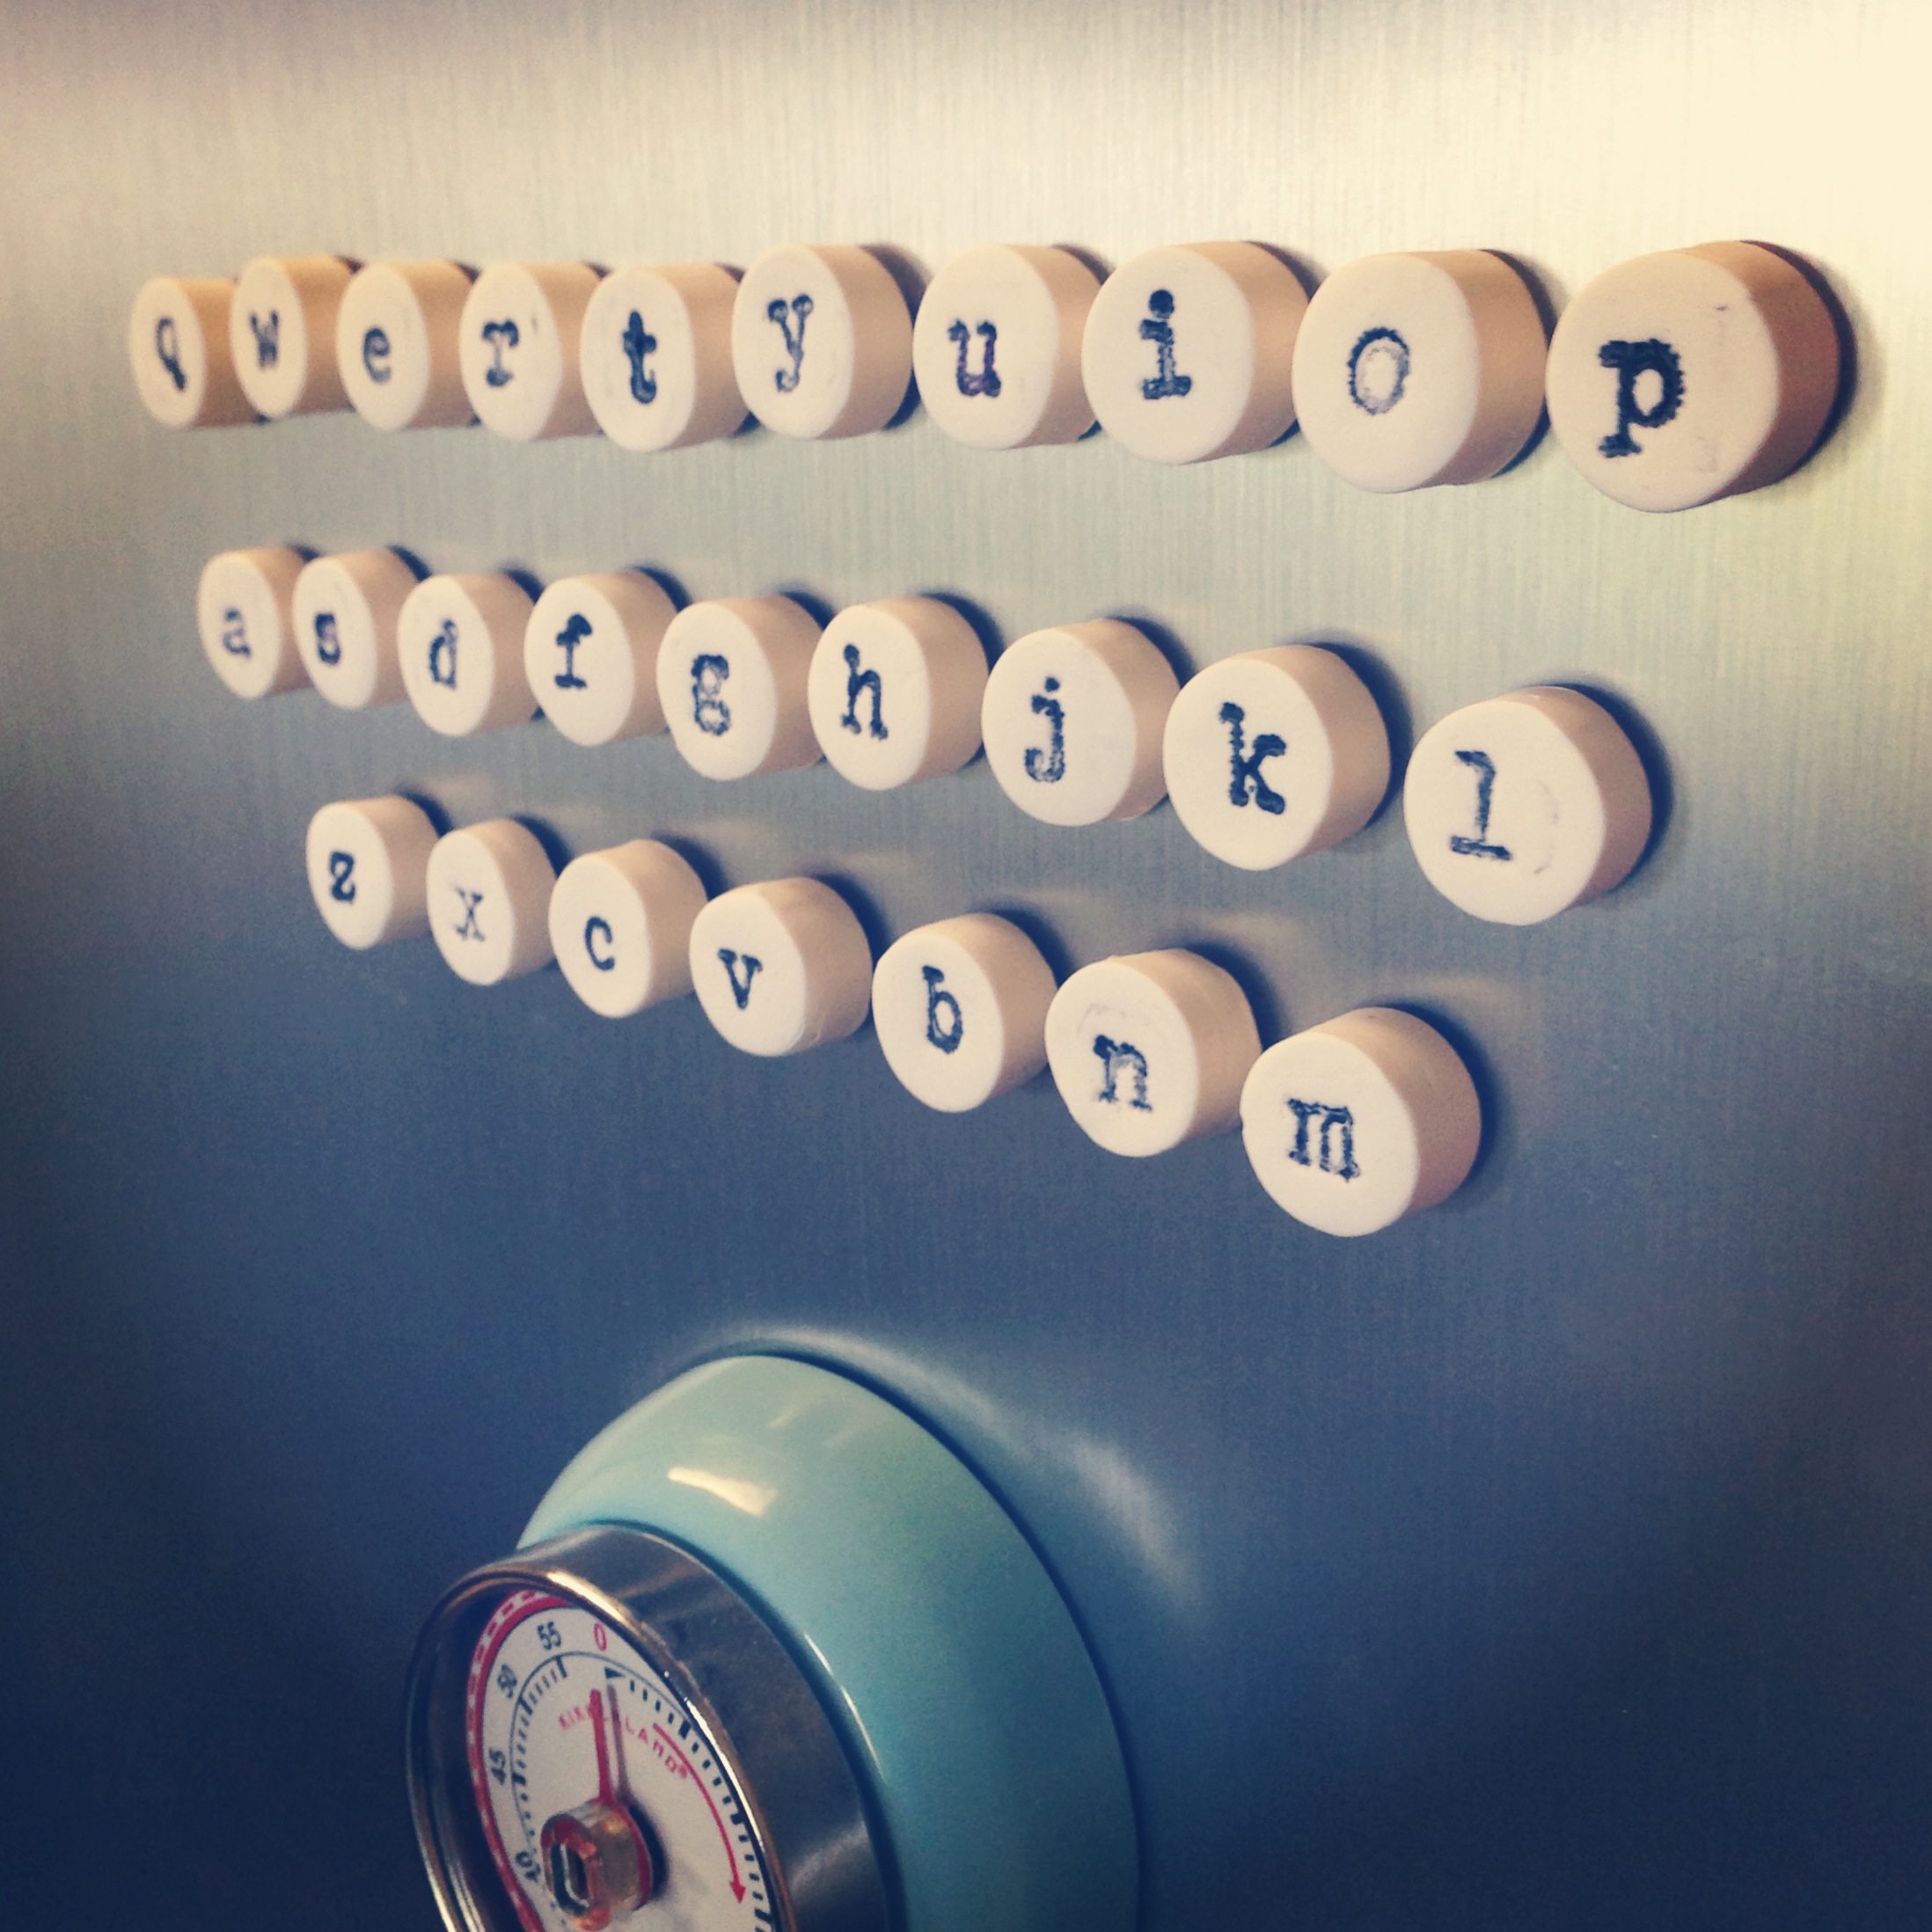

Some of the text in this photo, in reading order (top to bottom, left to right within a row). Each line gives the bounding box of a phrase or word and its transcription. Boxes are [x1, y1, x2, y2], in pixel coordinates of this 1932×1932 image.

[156, 289, 1686, 458] q w e r t y u i o p
[222, 607, 252, 659] a
[313, 612, 341, 666] s
[428, 618, 457, 689] d
[554, 613, 593, 690] f
[691, 654, 730, 736] g
[841, 644, 889, 741] h
[1024, 677, 1065, 783] j
[1218, 701, 1287, 816] k
[329, 851, 1360, 1182] z x c v b n m
[537, 1621, 562, 1650] 55
[594, 1621, 608, 1652] 0
[496, 1663, 518, 1699] 50
[489, 1745, 507, 1786] 45
